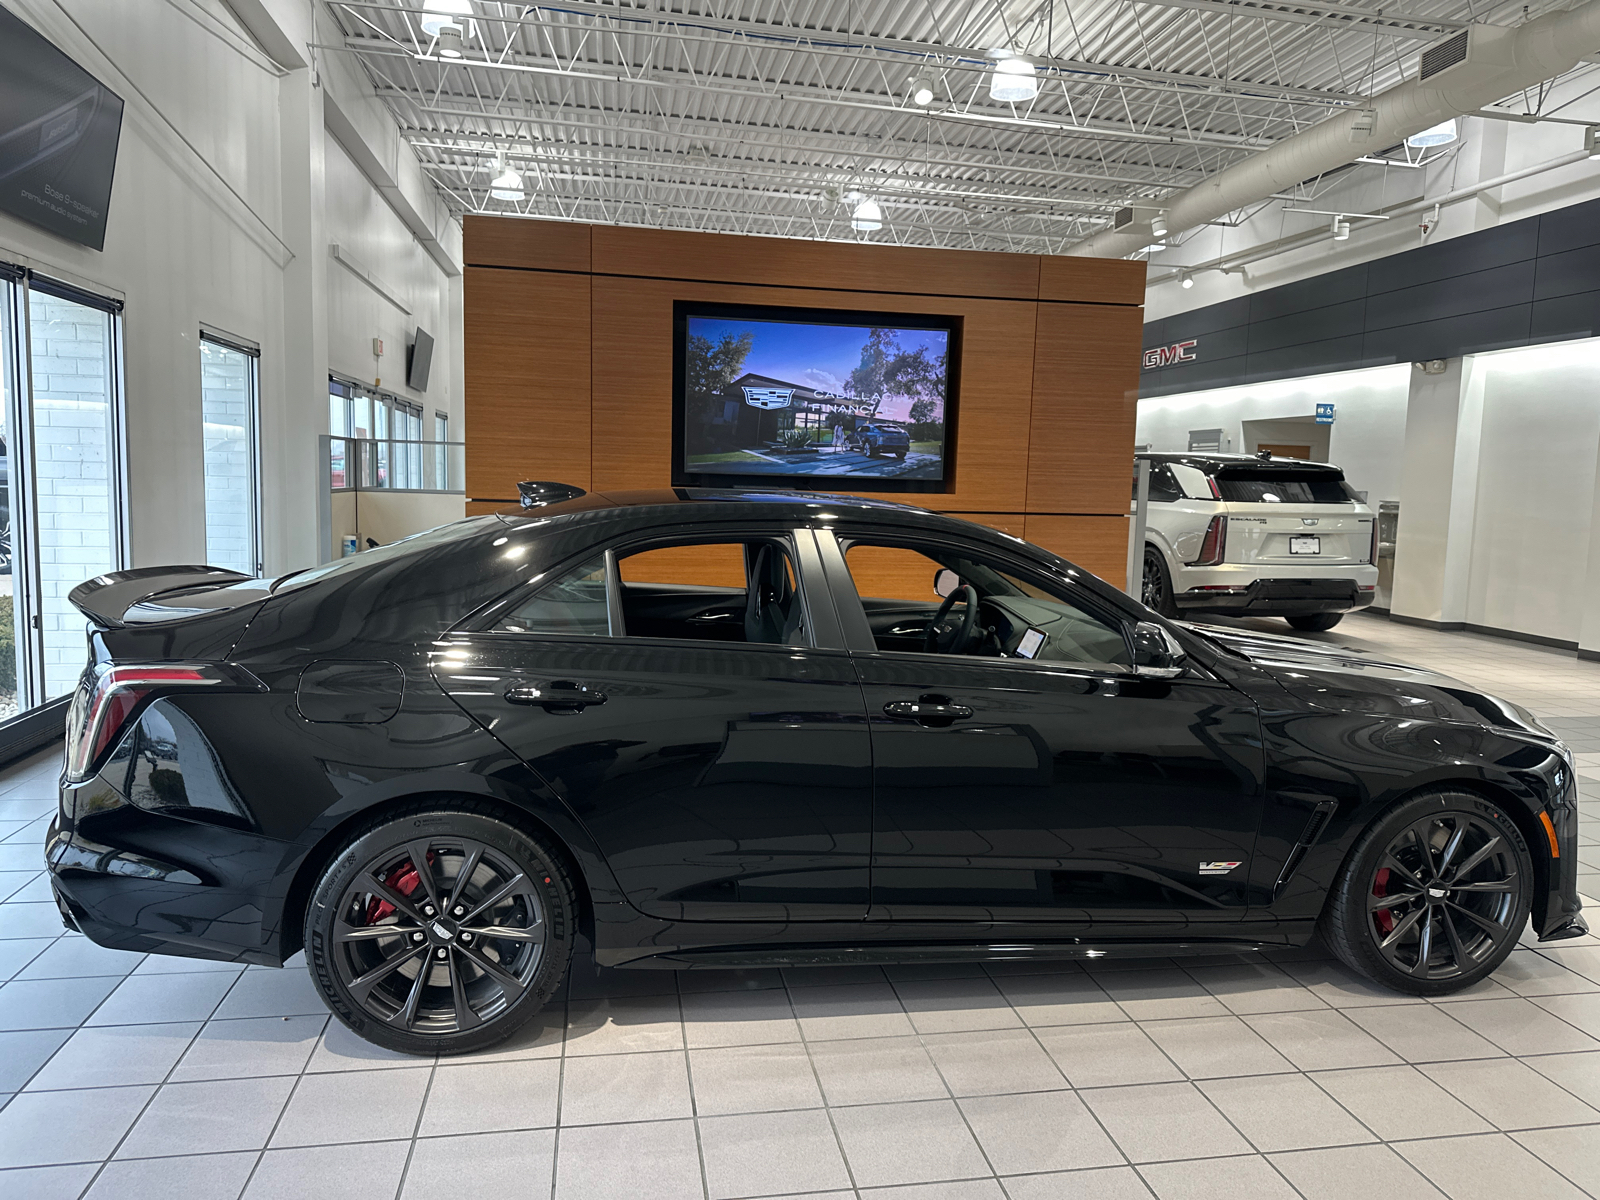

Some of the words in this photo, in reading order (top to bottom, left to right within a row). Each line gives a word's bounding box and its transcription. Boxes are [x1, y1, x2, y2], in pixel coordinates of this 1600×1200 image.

[21, 189, 50, 209] premium
[50, 202, 67, 216] audio
[66, 211, 88, 226] system
[44, 183, 64, 202] Bose
[64, 194, 99, 219] 9-speaker
[1143, 339, 1197, 369] GMC
[812, 403, 894, 414] FINANCIAL
[813, 390, 891, 400] CADILLAC
[322, 873, 339, 899] SPORT
[312, 935, 348, 1018] MICHELIN
